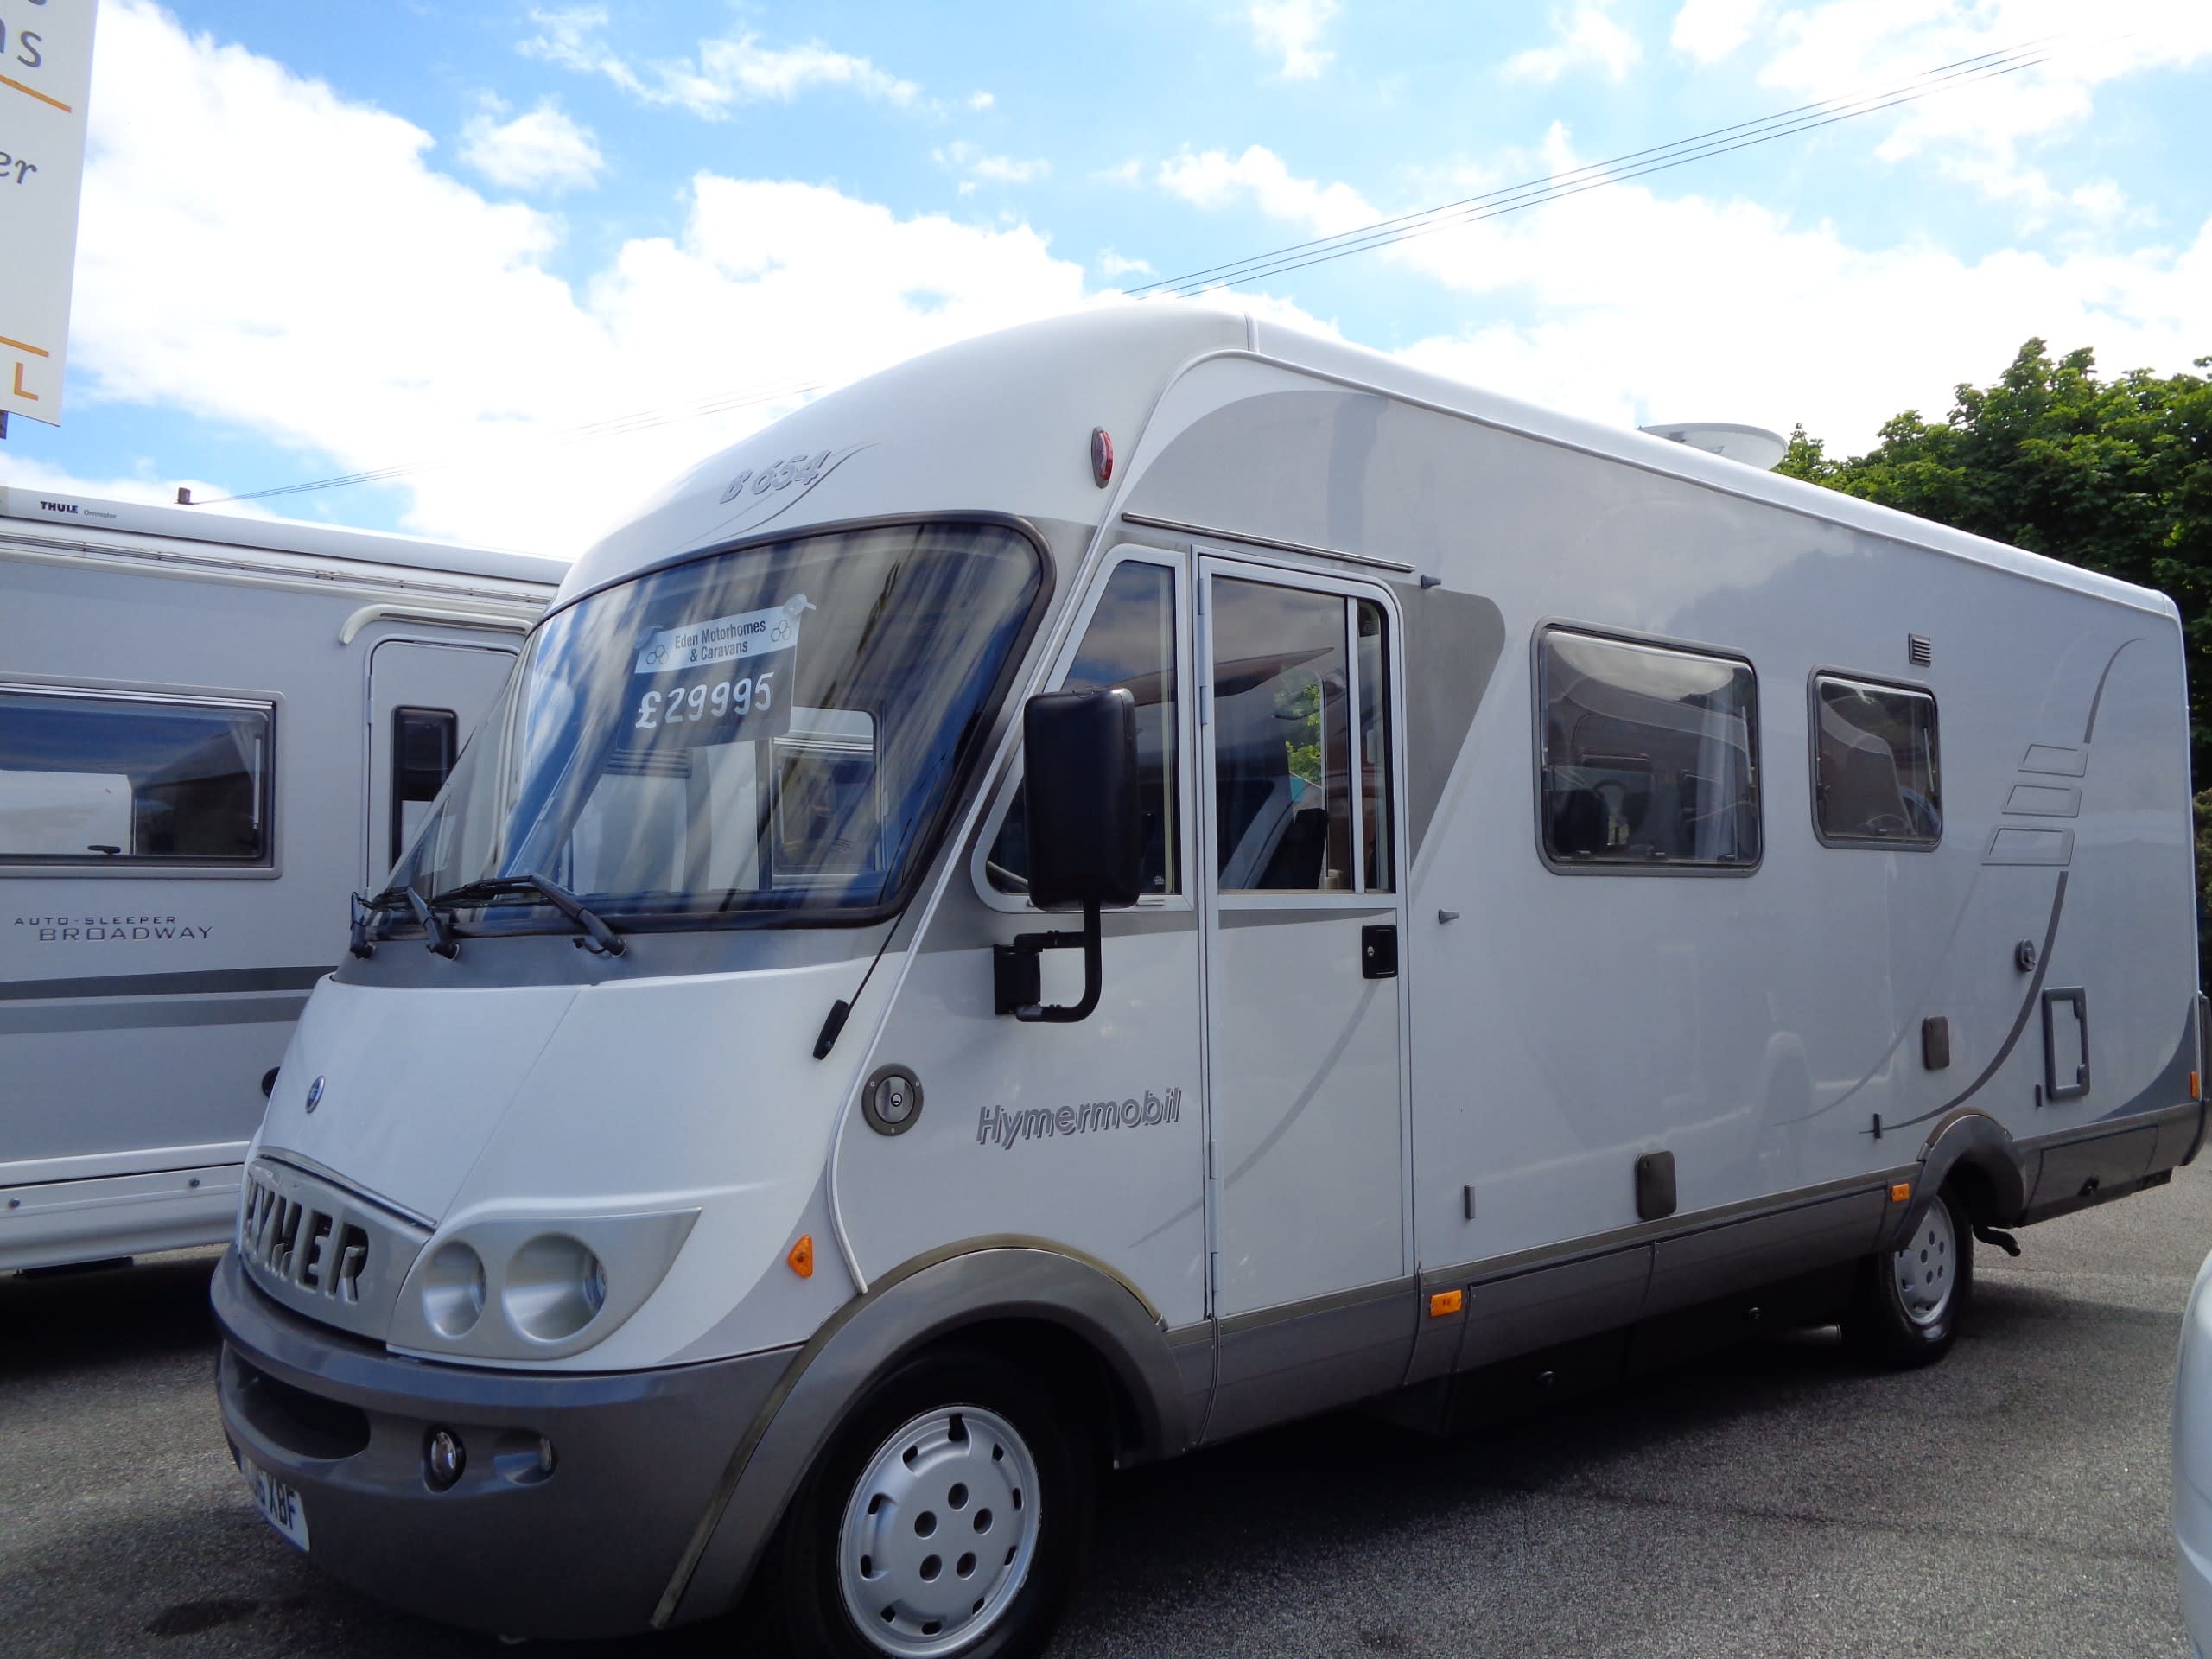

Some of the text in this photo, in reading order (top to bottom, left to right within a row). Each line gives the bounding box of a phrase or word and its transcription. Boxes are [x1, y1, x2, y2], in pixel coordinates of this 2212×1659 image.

[752, 449, 831, 495] 654
[41, 501, 78, 513] THULE
[675, 620, 766, 650] Eden Motorhomes
[690, 641, 748, 662] & Caravans
[635, 671, 775, 729] £29995
[39, 926, 213, 941] BROADWAY
[976, 1087, 1182, 1150] Hymermobil
[245, 1177, 369, 1305] HYMER
